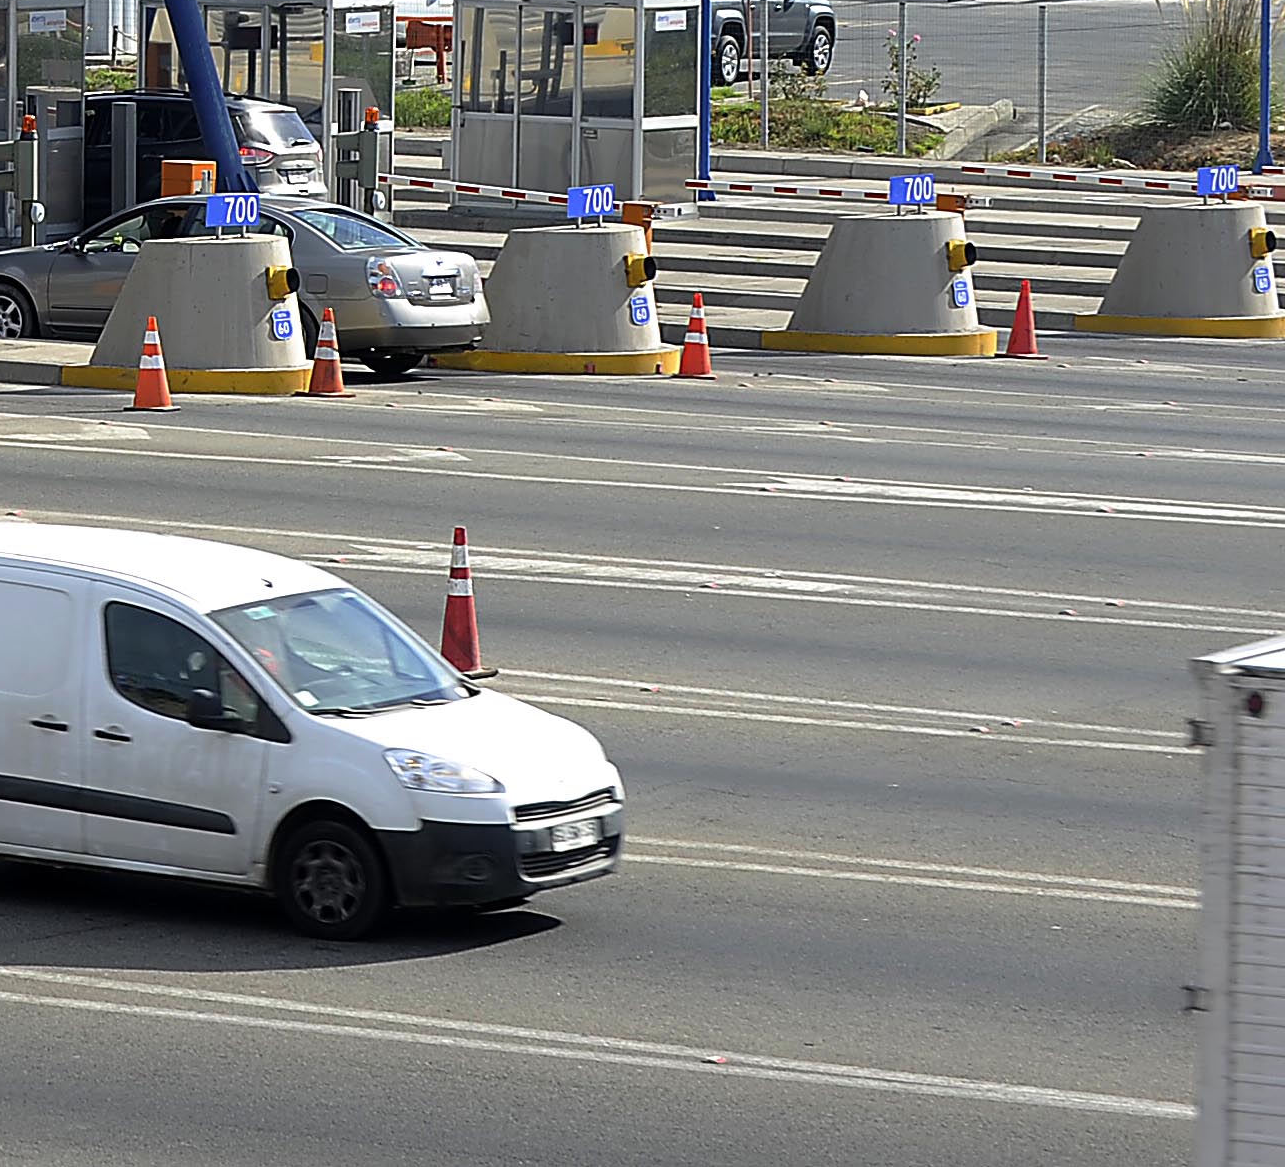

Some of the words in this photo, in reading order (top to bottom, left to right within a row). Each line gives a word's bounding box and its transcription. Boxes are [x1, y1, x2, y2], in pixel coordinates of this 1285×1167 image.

[904, 176, 932, 202] 700
[1210, 166, 1236, 192] 700
[223, 196, 258, 224] 700
[583, 186, 613, 214] 700
[278, 321, 290, 335] 60
